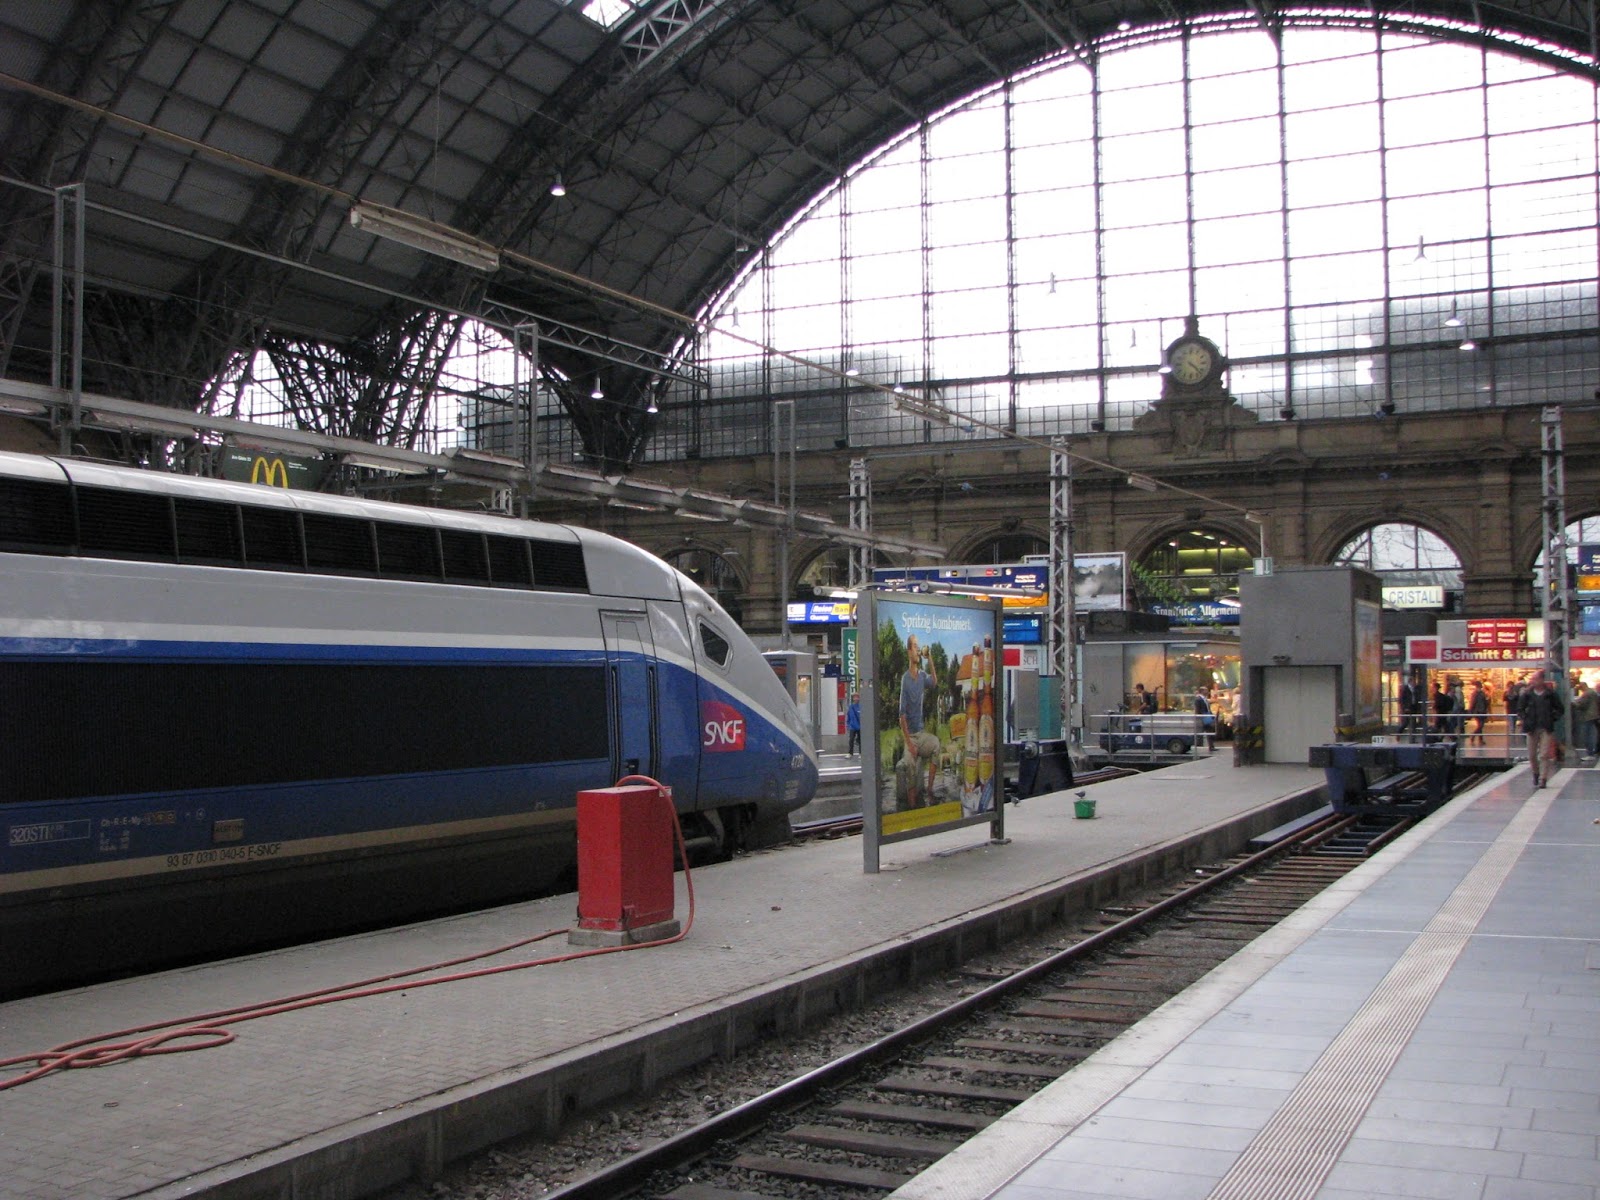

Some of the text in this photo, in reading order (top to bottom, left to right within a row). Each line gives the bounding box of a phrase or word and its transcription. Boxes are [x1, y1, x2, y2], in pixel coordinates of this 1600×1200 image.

[1389, 590, 1442, 605] CRISTALL
[902, 612, 931, 634] Spritzig
[1443, 649, 1500, 660] Schmitt
[1502, 649, 1514, 660] &
[703, 719, 743, 746] SNCF
[166, 855, 179, 868] 93
[182, 853, 193, 866] 87
